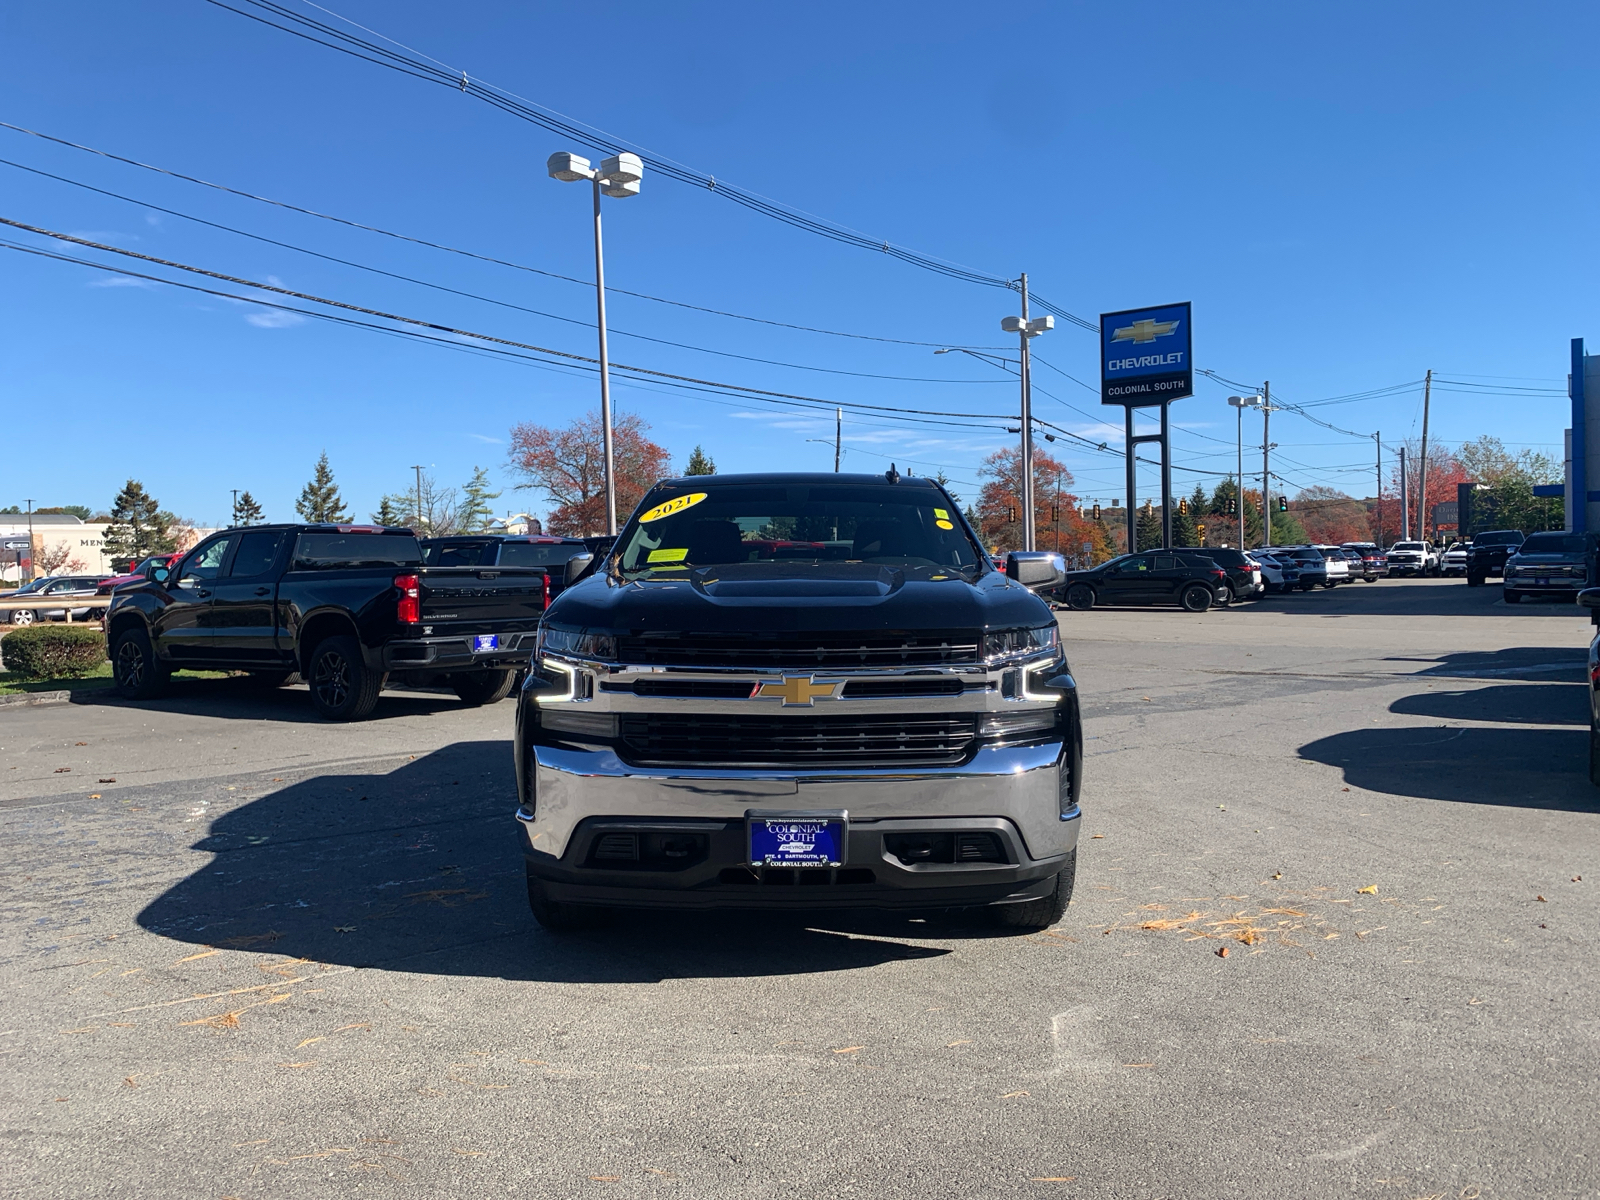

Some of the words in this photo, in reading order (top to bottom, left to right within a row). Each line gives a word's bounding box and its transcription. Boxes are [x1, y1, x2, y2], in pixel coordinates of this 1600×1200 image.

[1108, 352, 1184, 371] CHEVROLET
[1108, 384, 1152, 396] COLONIAL
[1154, 380, 1185, 391] SOUTH
[652, 496, 691, 519] 2021
[80, 539, 106, 547] MEN'
[431, 588, 540, 598] CHEVRO
[768, 825, 824, 833] COLONIAL
[777, 833, 815, 842] SOUTH
